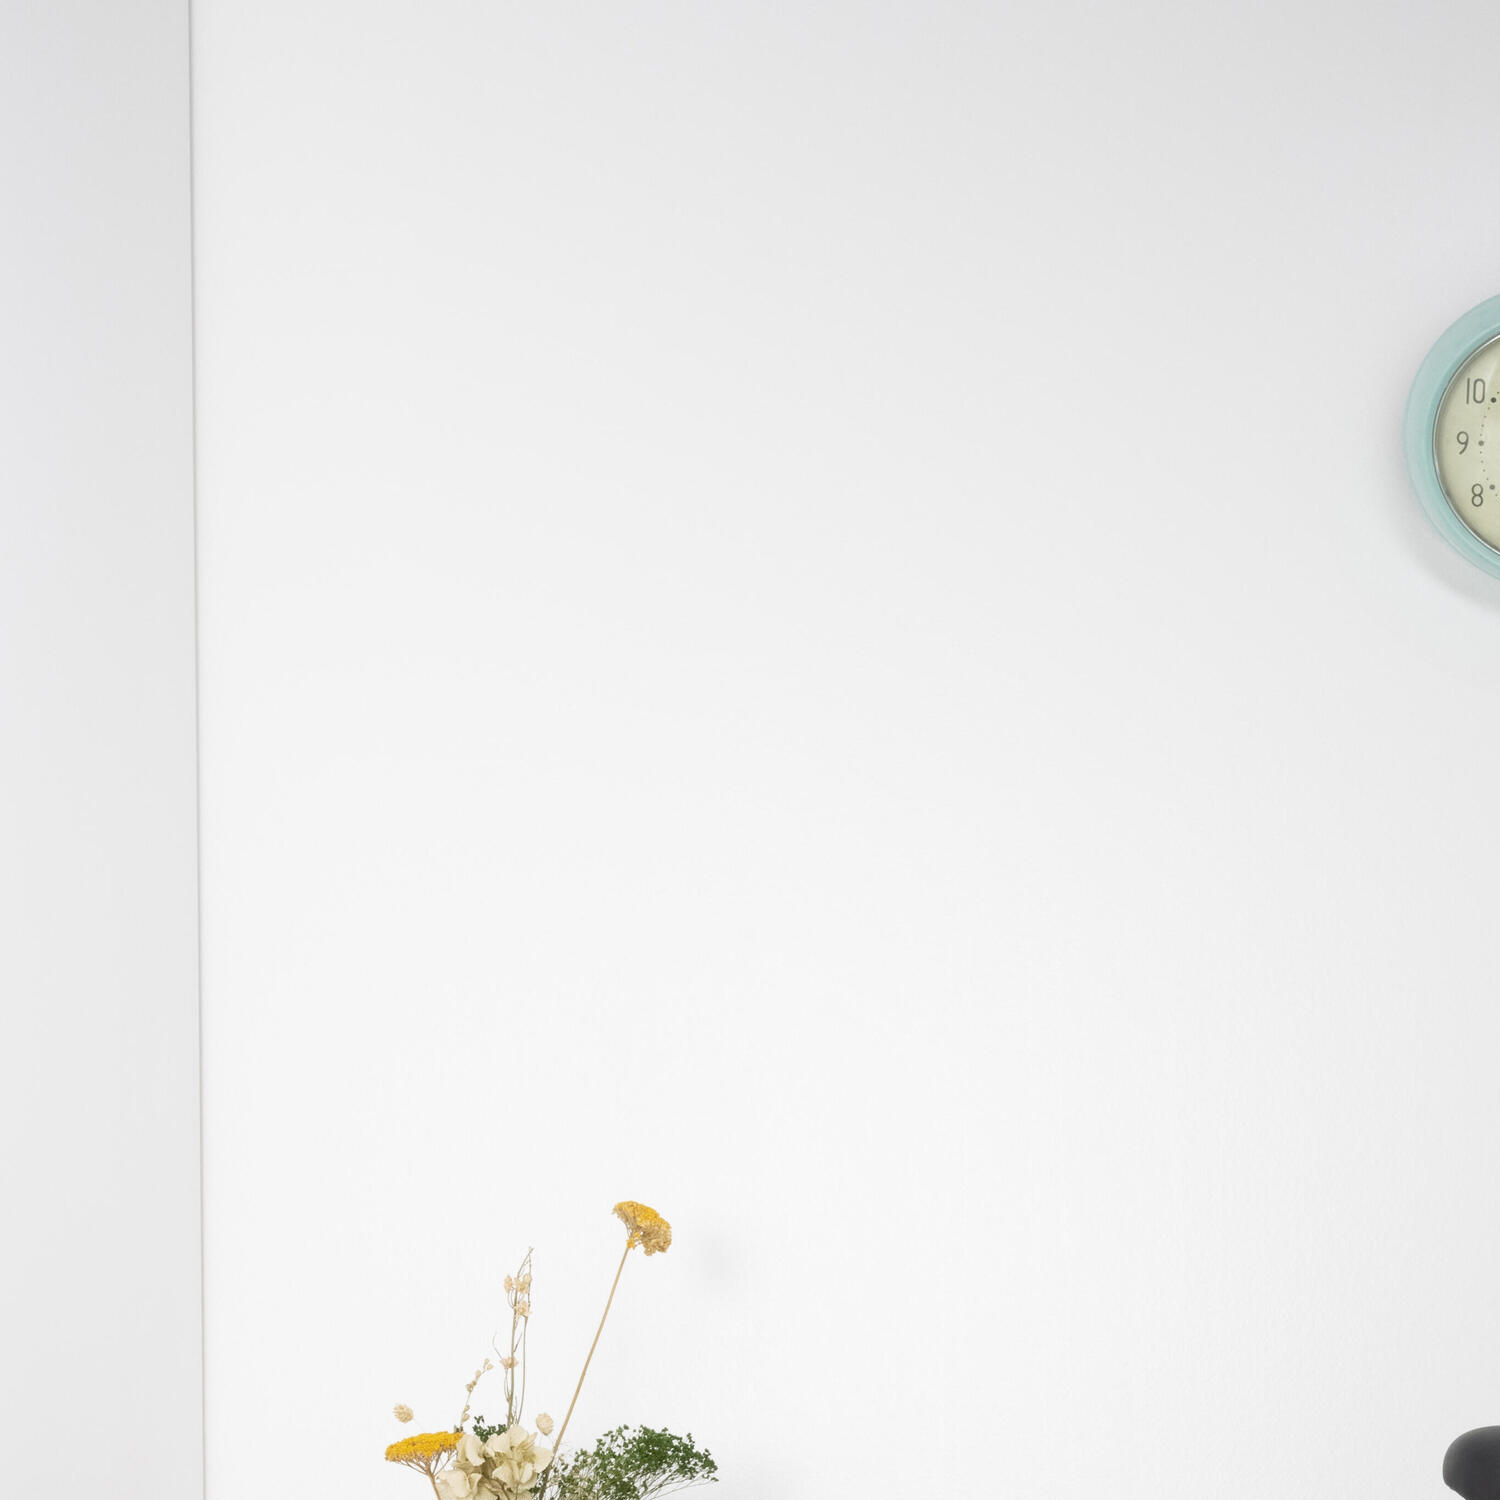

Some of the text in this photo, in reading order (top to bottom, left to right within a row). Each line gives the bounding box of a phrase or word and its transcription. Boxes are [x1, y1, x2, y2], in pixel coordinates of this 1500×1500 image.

[1465, 377, 1487, 405] 10
[1456, 430, 1470, 455] 9
[1470, 483, 1485, 507] 8
